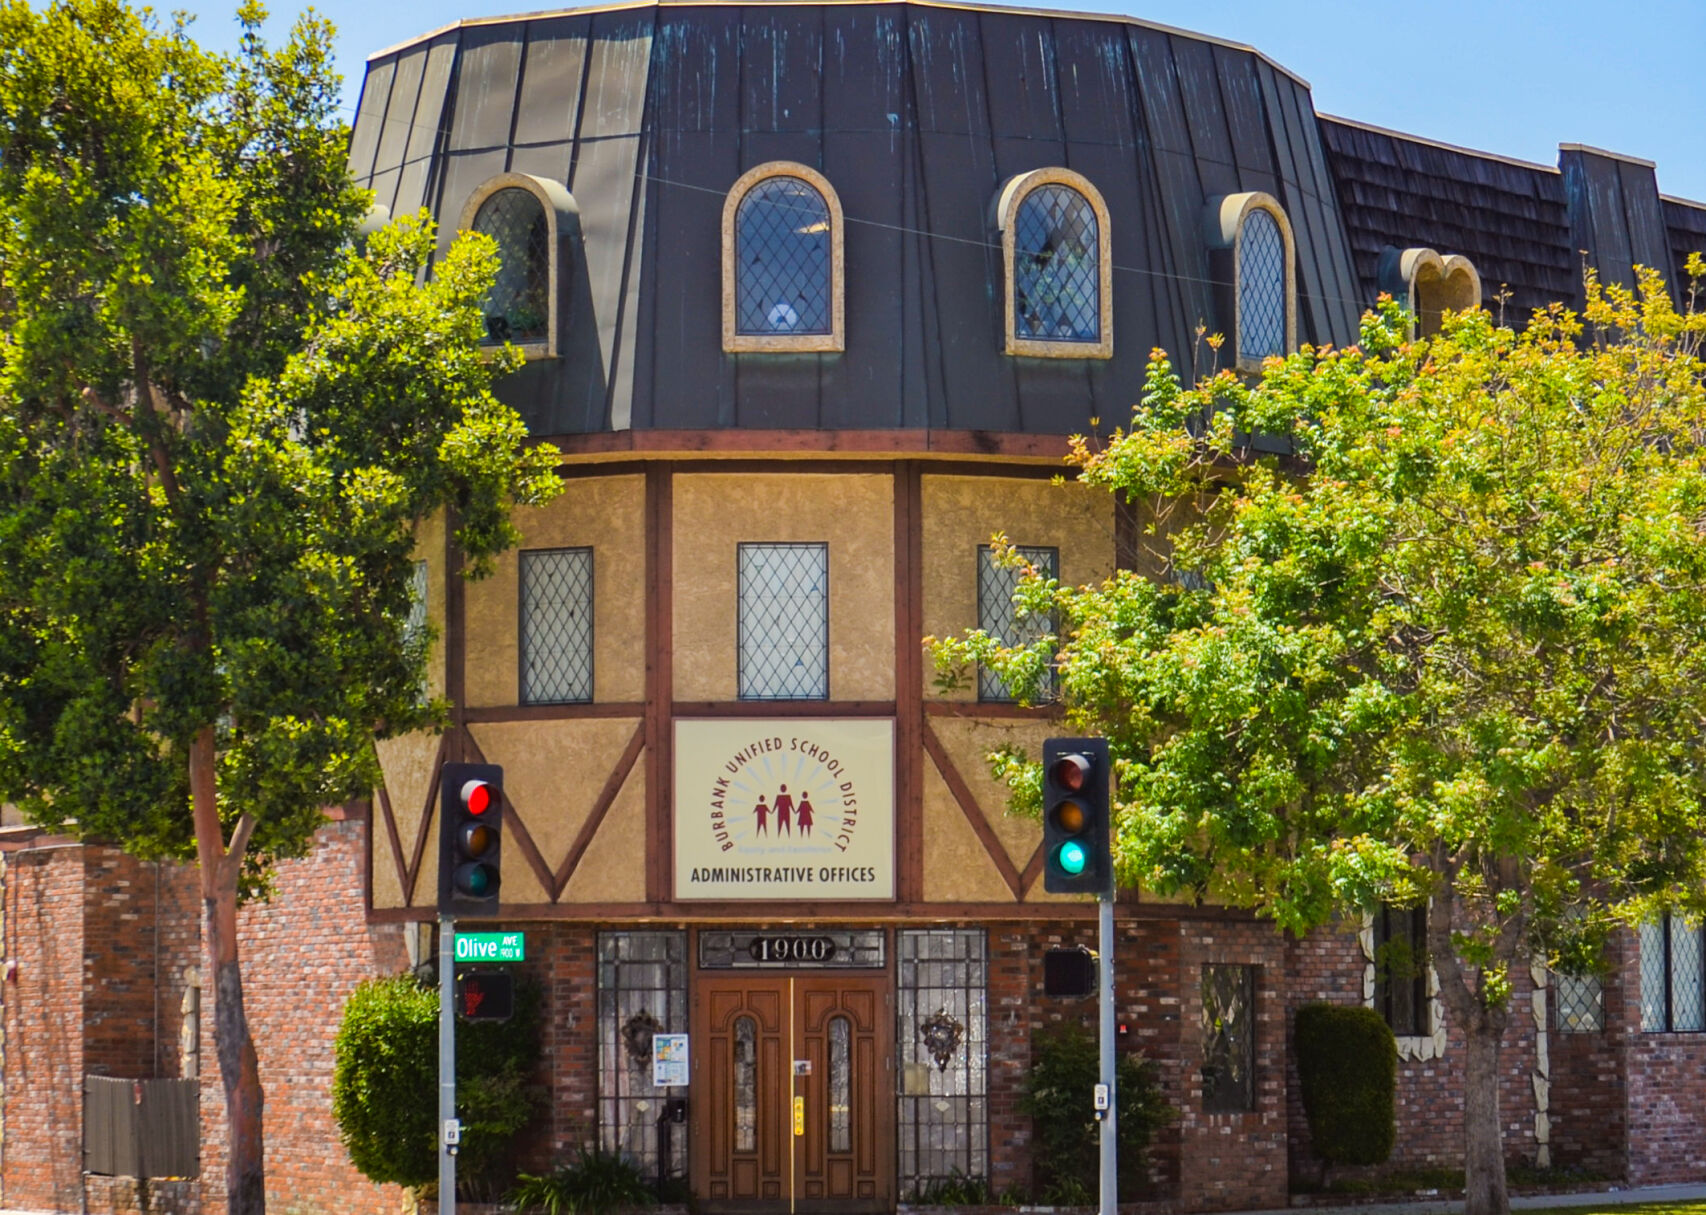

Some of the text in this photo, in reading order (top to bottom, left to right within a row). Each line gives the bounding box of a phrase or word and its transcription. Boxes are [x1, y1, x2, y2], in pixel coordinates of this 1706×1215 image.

[711, 737, 857, 852] BURBANK UNIFIED SCHOOL DISTRICT
[691, 867, 875, 883] ADMINISTRATIVE OFFICES
[457, 936, 518, 958] Olive AVE
[761, 939, 826, 960] 1900
